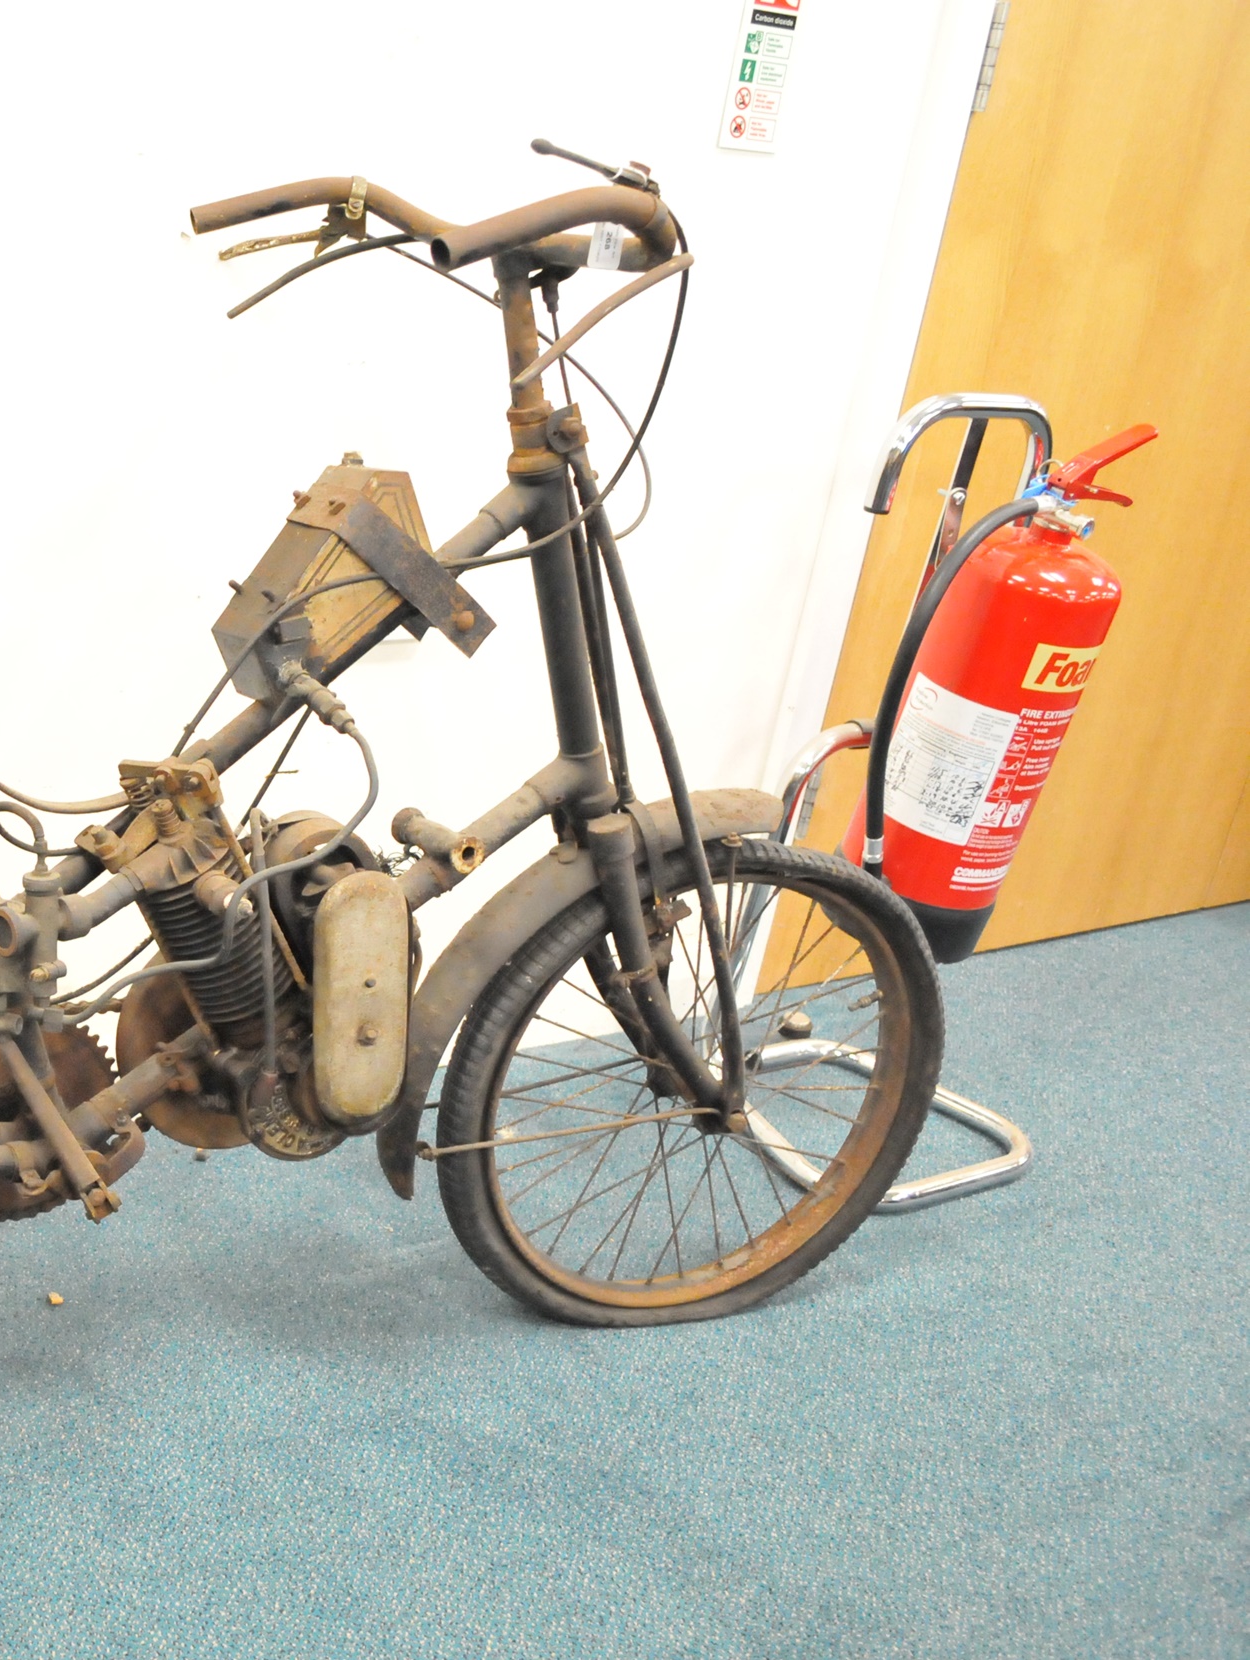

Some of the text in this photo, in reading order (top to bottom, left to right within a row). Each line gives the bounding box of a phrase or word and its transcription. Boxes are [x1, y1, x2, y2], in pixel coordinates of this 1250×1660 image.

[755, 14, 793, 26] Carbon dioxide
[1020, 708, 1044, 719] FIRE
